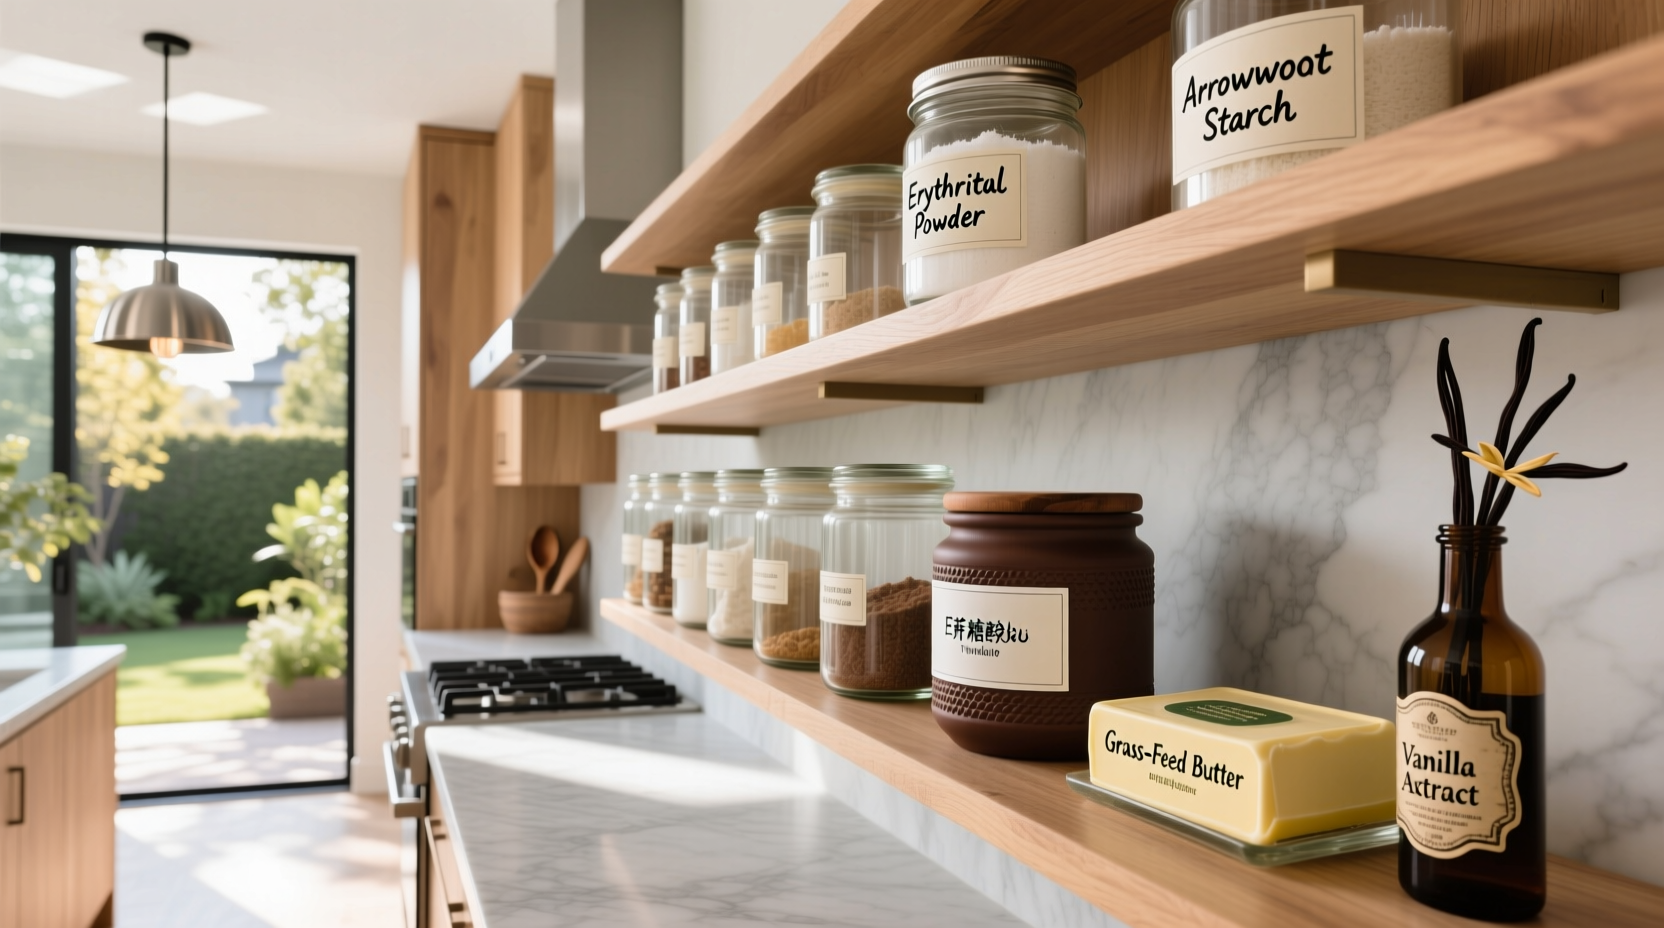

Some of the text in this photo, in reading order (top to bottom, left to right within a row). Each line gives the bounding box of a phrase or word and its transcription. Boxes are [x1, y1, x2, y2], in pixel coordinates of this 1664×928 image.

[1203, 89, 1297, 141] Starch
[908, 165, 1008, 212] Erythrital
[914, 202, 986, 240] Powder
[1105, 729, 1187, 774] Grass-Feed
[1192, 754, 1244, 790] Butter
[1402, 742, 1477, 778] Vanilla
